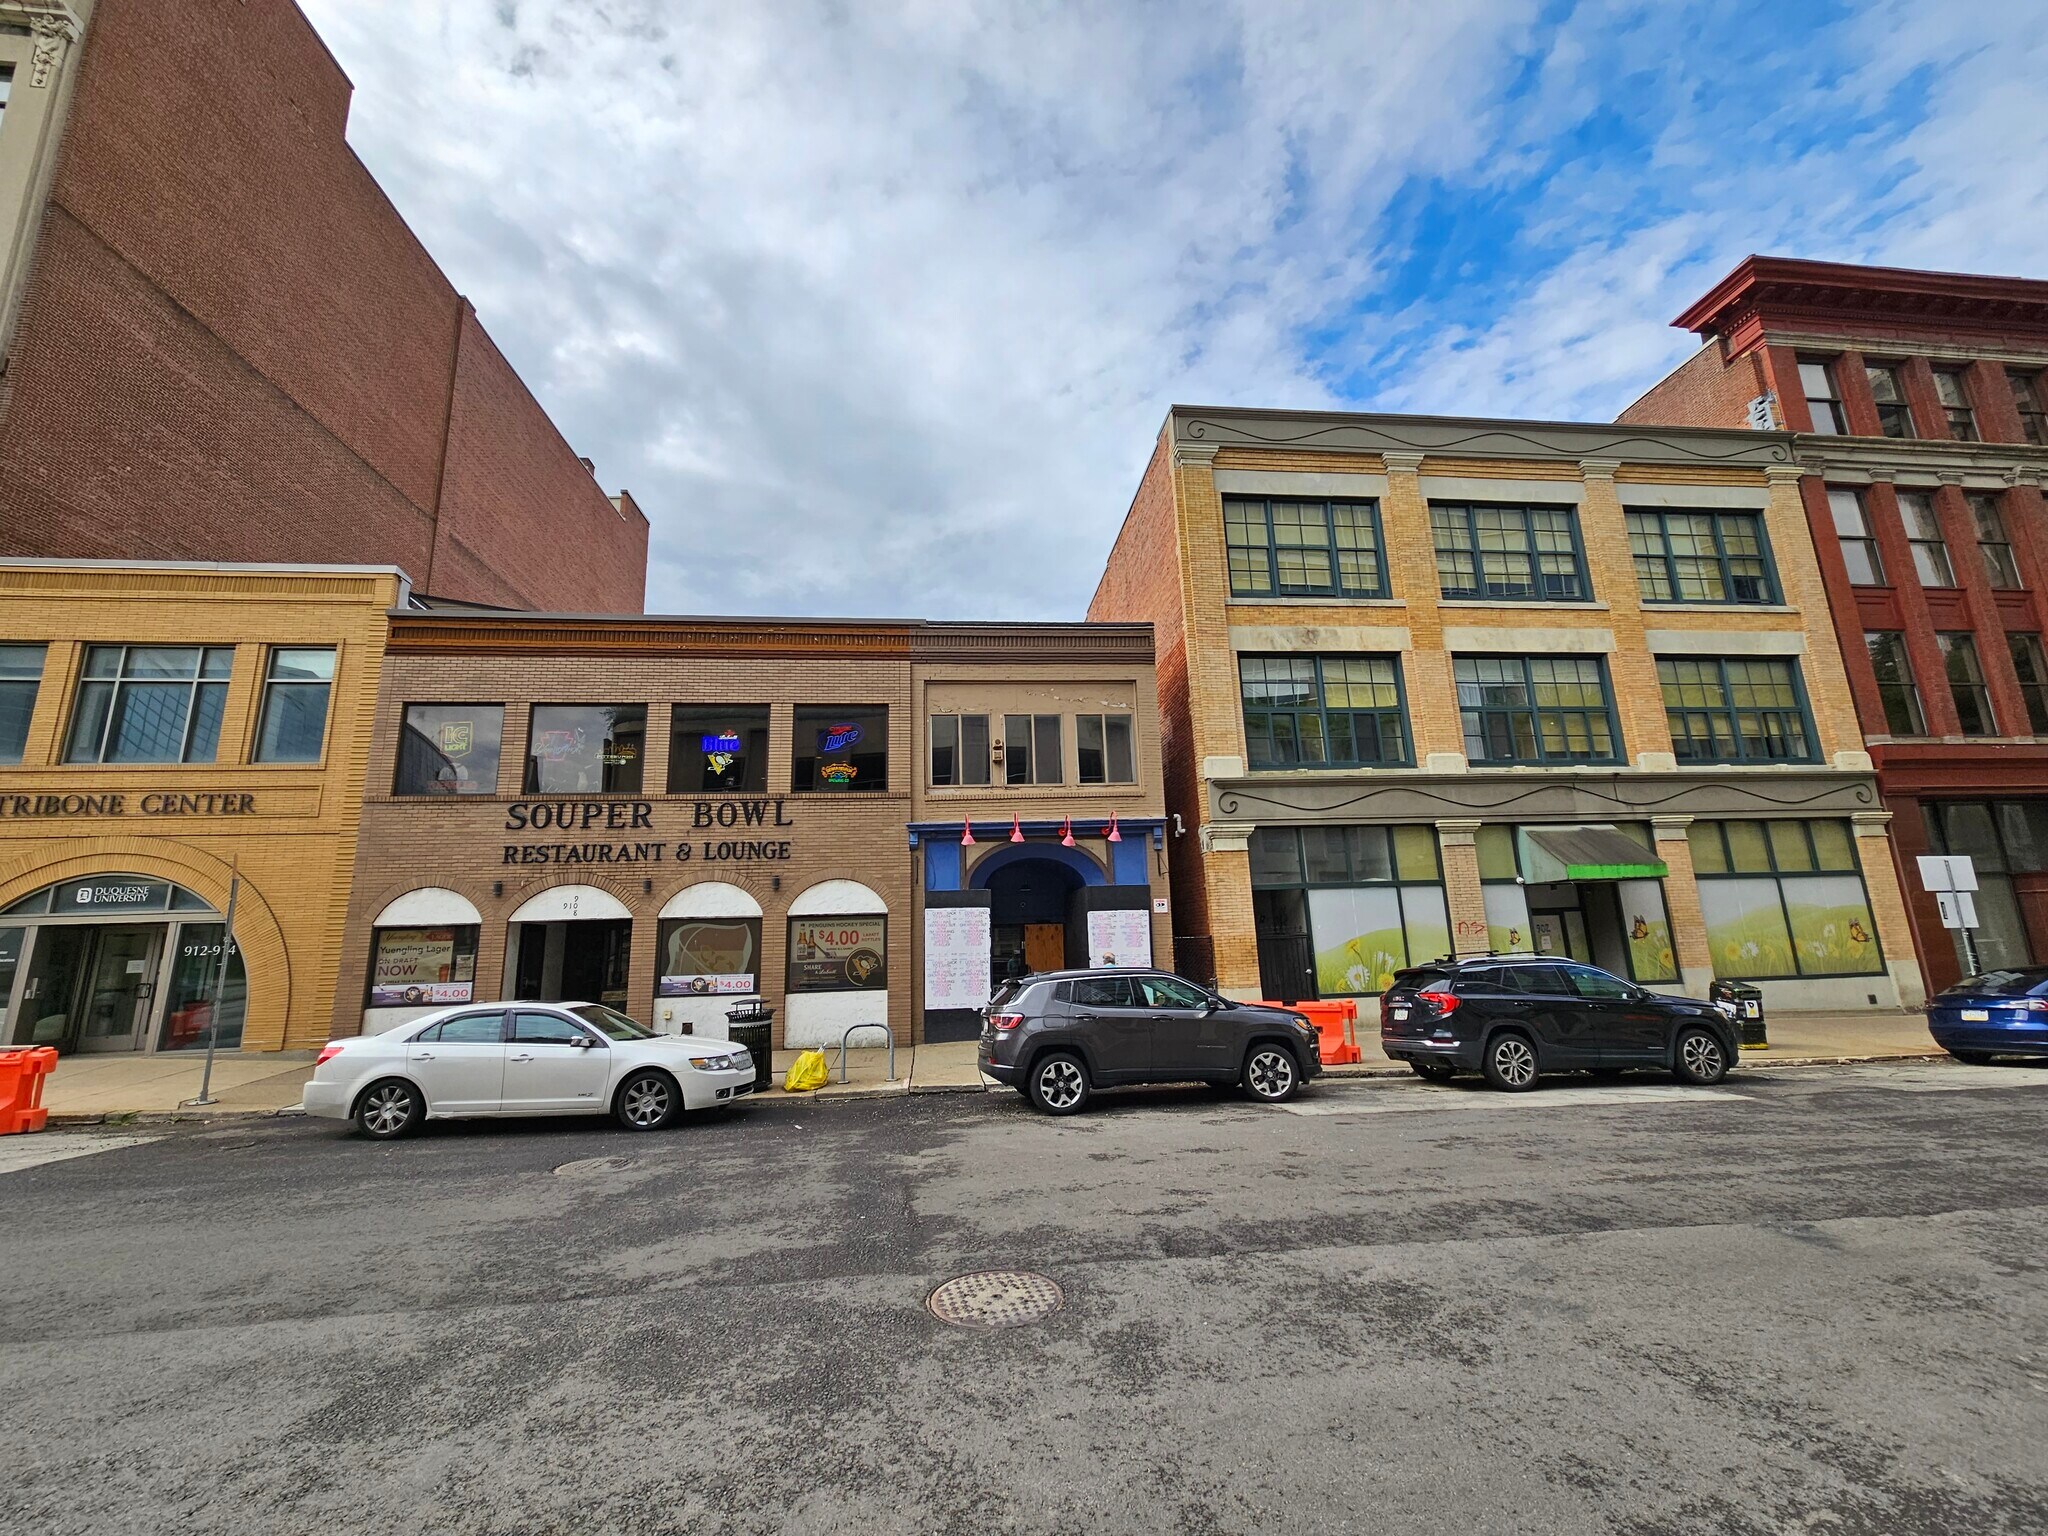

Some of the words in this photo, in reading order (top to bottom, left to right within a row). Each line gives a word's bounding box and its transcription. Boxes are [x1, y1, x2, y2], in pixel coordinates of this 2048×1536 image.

[702, 735, 740, 752] Blue
[824, 730, 859, 751] Lite
[140, 793, 256, 815] CENTER
[505, 801, 653, 830] SOUPER
[691, 800, 793, 828] BOWL
[502, 842, 666, 864] RESTAURANT
[675, 842, 692, 862] &
[703, 841, 791, 861] LOUNGE
[95, 886, 150, 896] DUQUESNE
[94, 894, 149, 903] UNIVERSITY
[1536, 923, 1551, 934] 902
[818, 930, 859, 946] $4.00
[184, 944, 236, 957] 912-94
[380, 946, 424, 955] Yuengling
[426, 945, 451, 954] Lager
[377, 965, 418, 977] NOW
[720, 980, 751, 989] $4.00
[435, 989, 469, 998] $4.00
